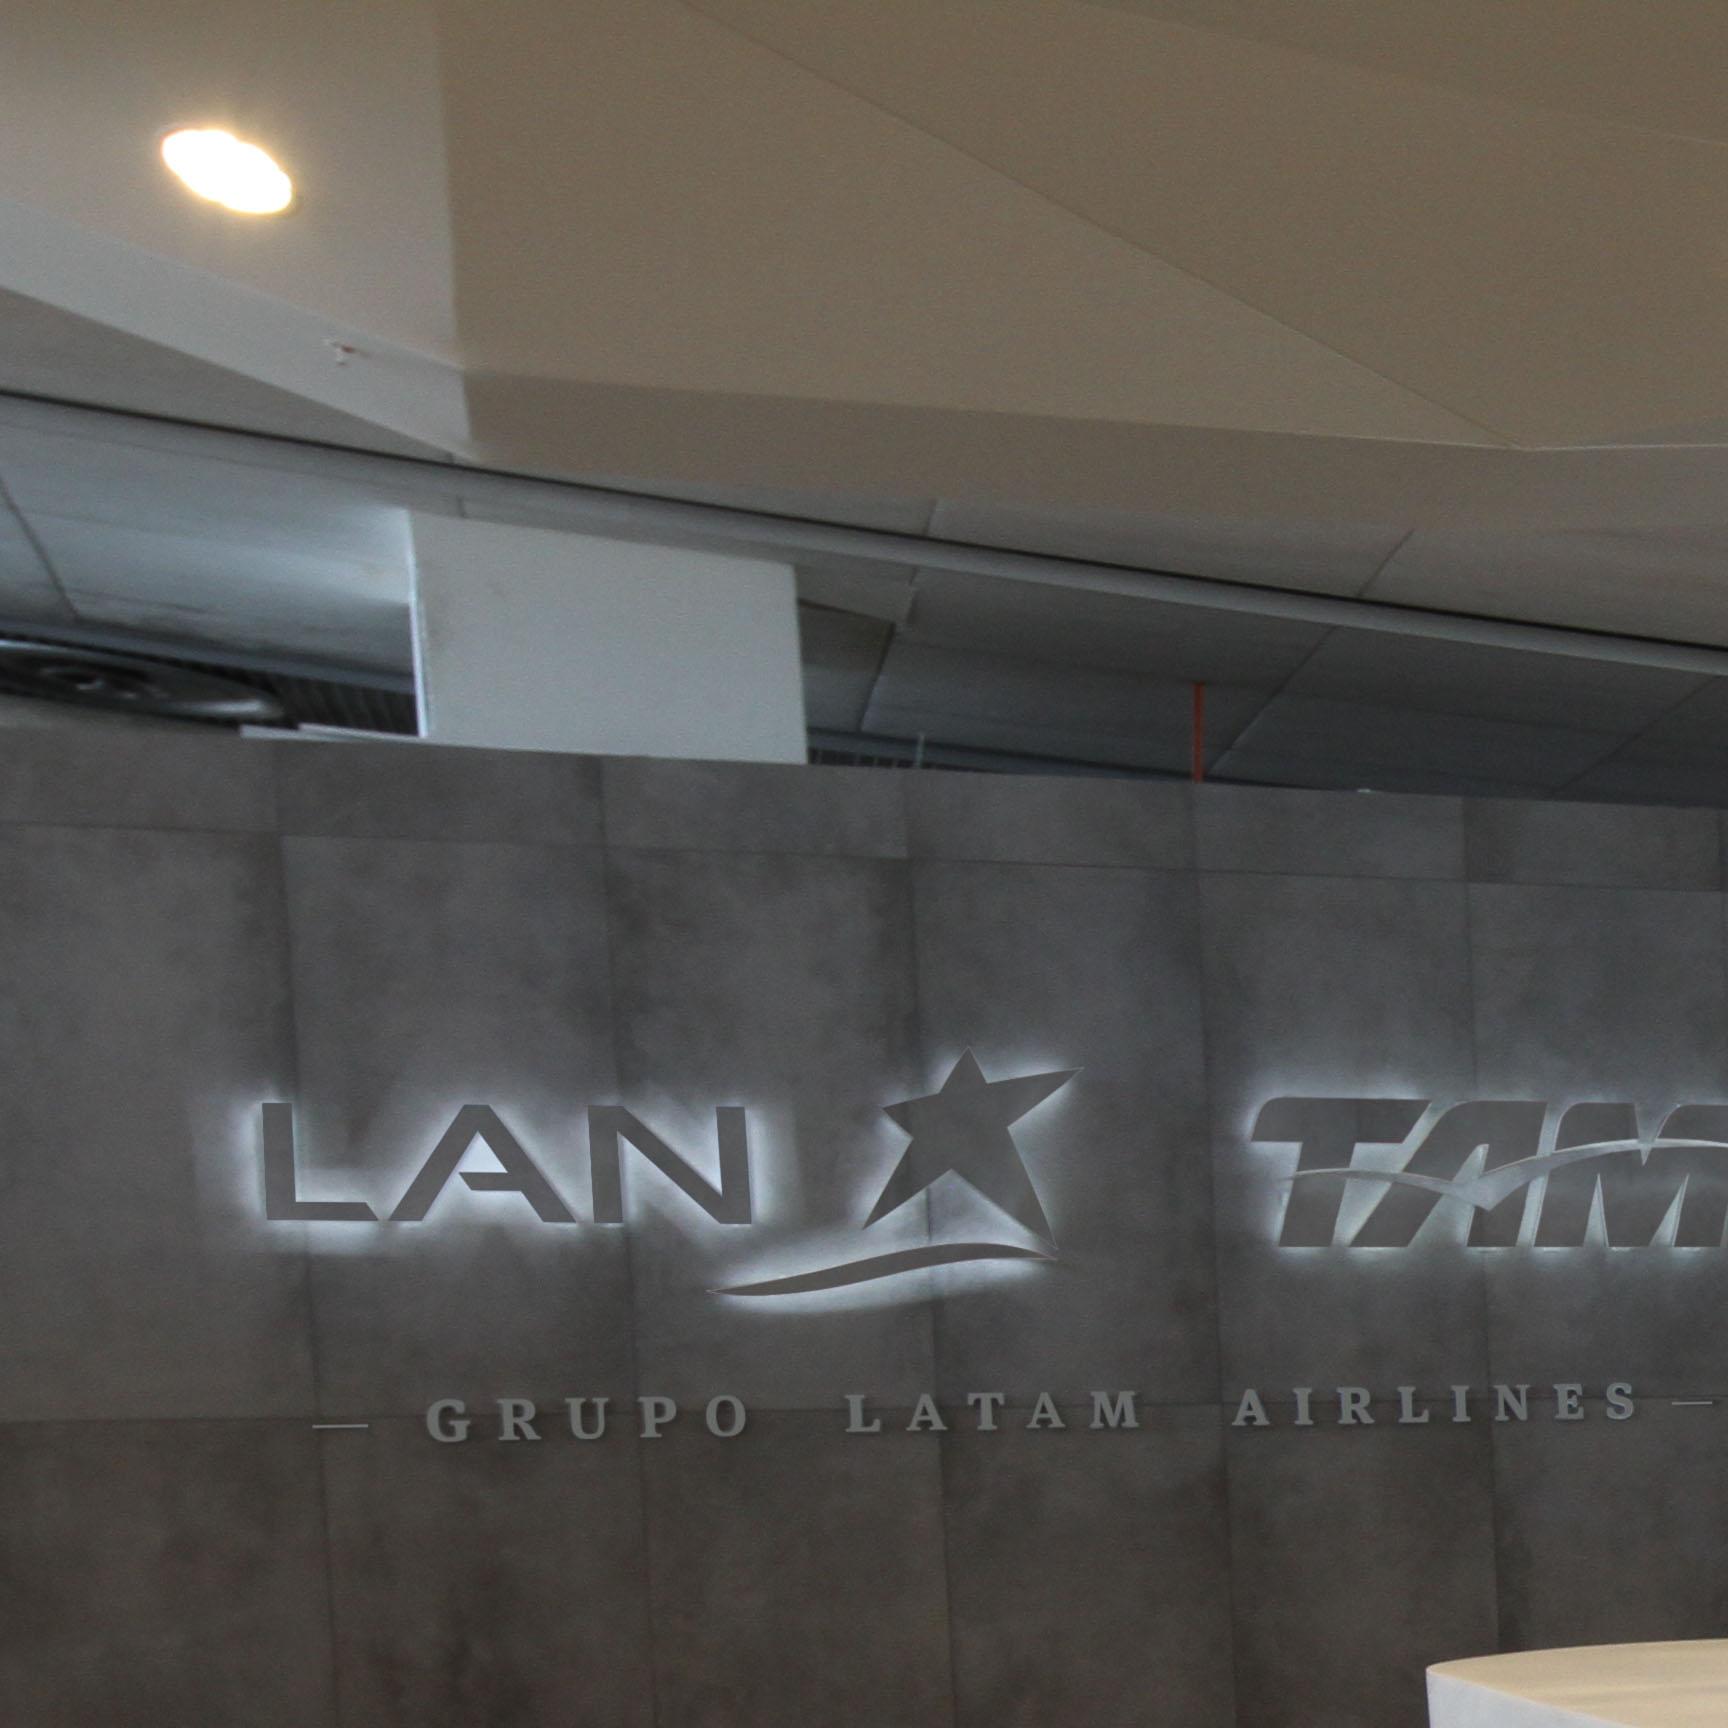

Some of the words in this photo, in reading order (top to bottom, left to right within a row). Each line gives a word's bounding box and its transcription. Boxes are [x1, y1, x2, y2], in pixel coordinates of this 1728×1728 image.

[261, 1102, 752, 1226] LAN
[425, 1395, 750, 1444] GRUPO
[844, 1392, 1141, 1436] LATAM
[1232, 1382, 1639, 1428] AIRLINES
